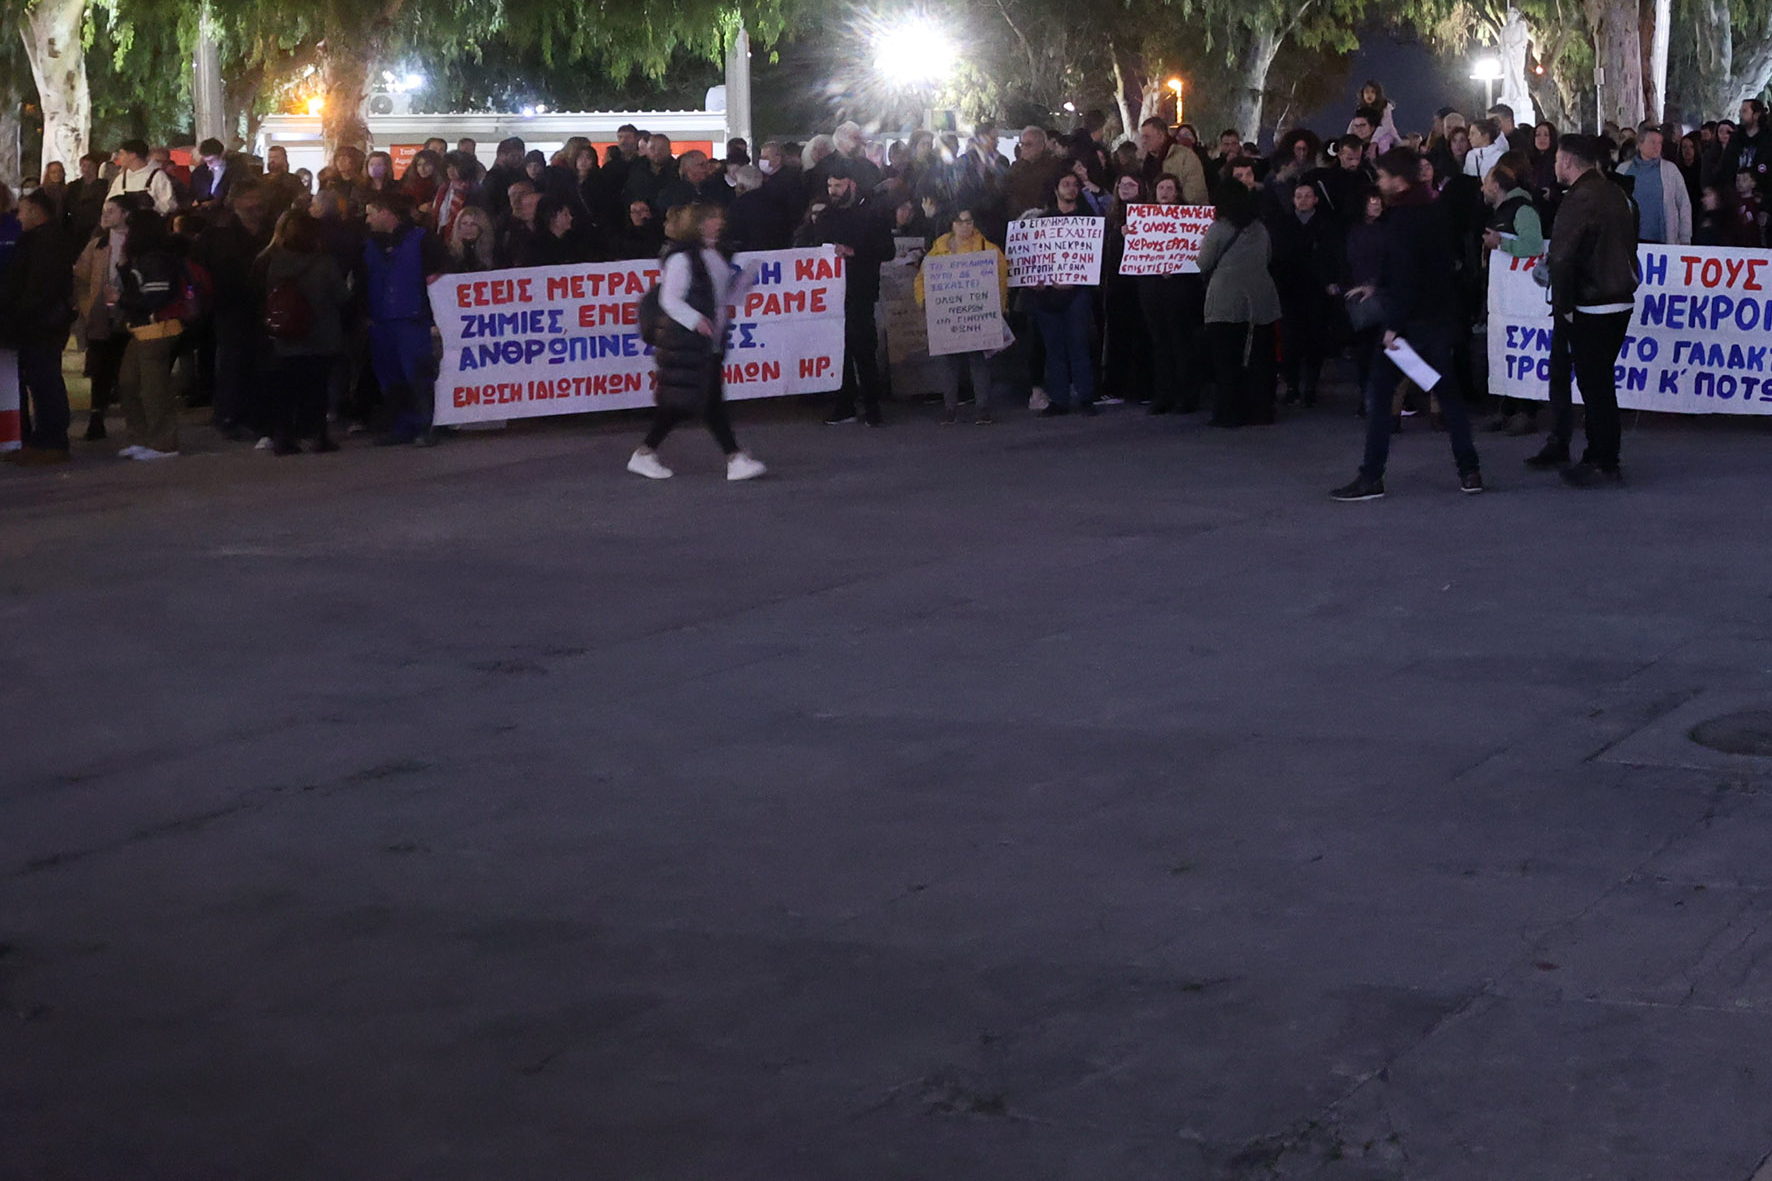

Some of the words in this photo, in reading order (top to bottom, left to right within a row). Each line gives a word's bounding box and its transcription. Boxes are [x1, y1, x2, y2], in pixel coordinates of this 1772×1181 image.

[1071, 217, 1096, 226] ΑΥΤΟ
[1009, 232, 1029, 242] ΔΕΝ
[1034, 229, 1047, 240] ΘΑ
[1054, 240, 1092, 250] ΝΕΚΡΩΝ
[1062, 251, 1094, 263] ΦΩΝΗ
[1681, 255, 1769, 291] ΤΟΥΣ
[457, 278, 532, 308] ΕΣΕΙΣ
[547, 269, 661, 300] ΜΕΤΡΑΤ
[795, 257, 842, 282] ΚΑΙ
[969, 291, 989, 301] ΤΩΝ
[453, 382, 523, 408] ΕΝΩΣΗ
[528, 372, 641, 400] ΙΔΙΩΤΙΚΩΝ
[799, 356, 836, 379] ΗΡ.
